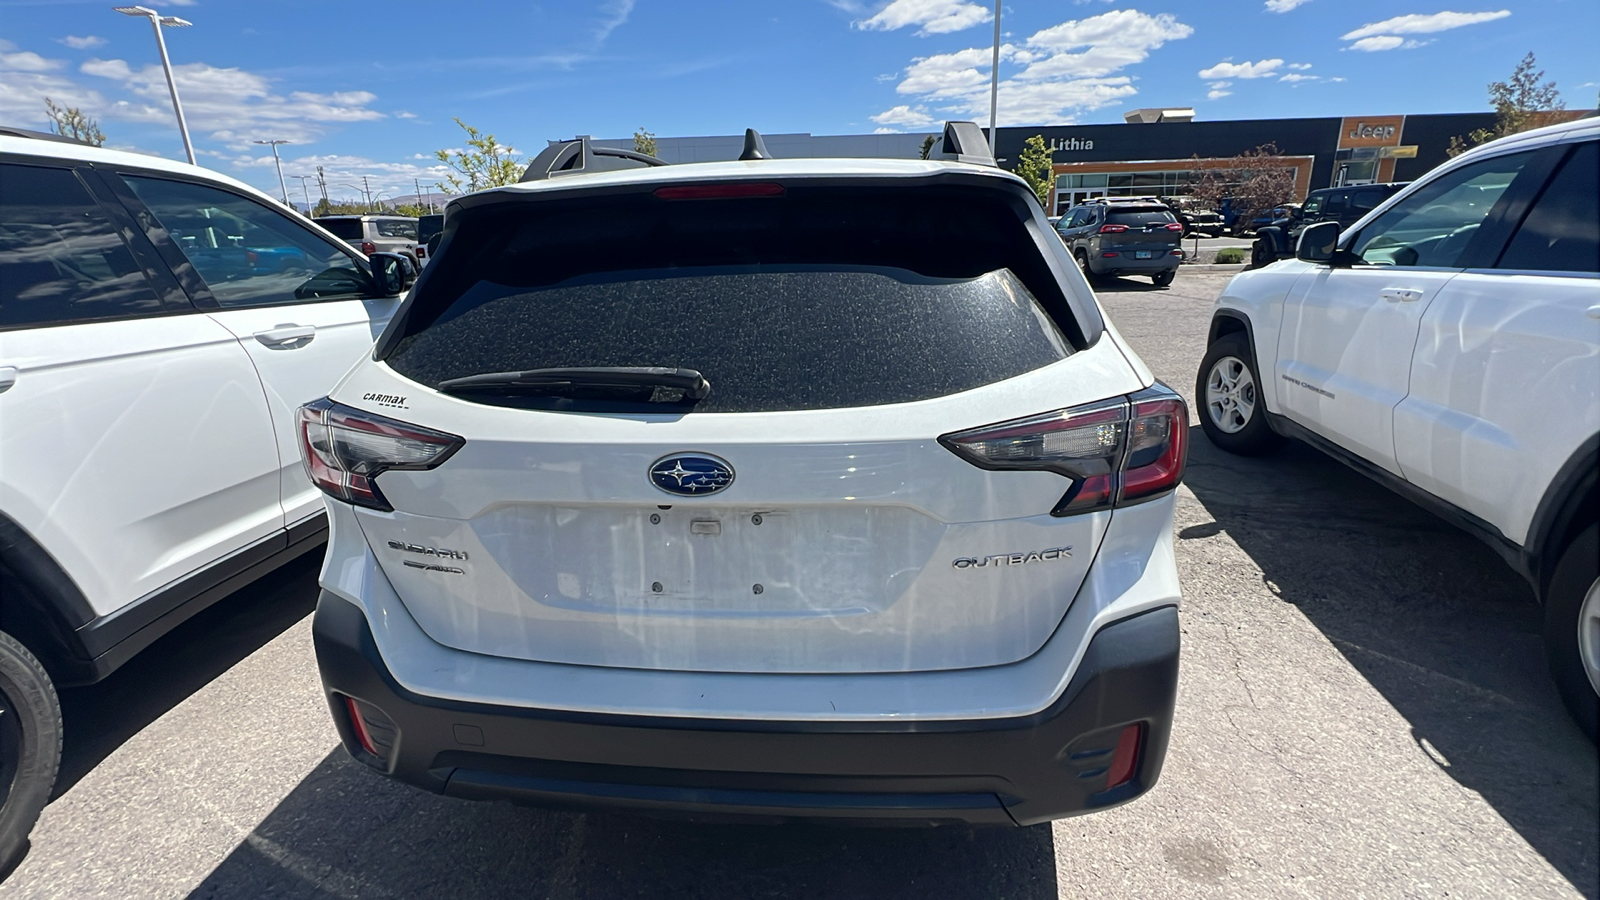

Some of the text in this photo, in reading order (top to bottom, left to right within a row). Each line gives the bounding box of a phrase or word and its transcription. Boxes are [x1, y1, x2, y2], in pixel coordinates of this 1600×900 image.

[1349, 122, 1396, 140] Jeep
[1050, 138, 1094, 151] Lithia
[952, 546, 1073, 570] OUTBACK
